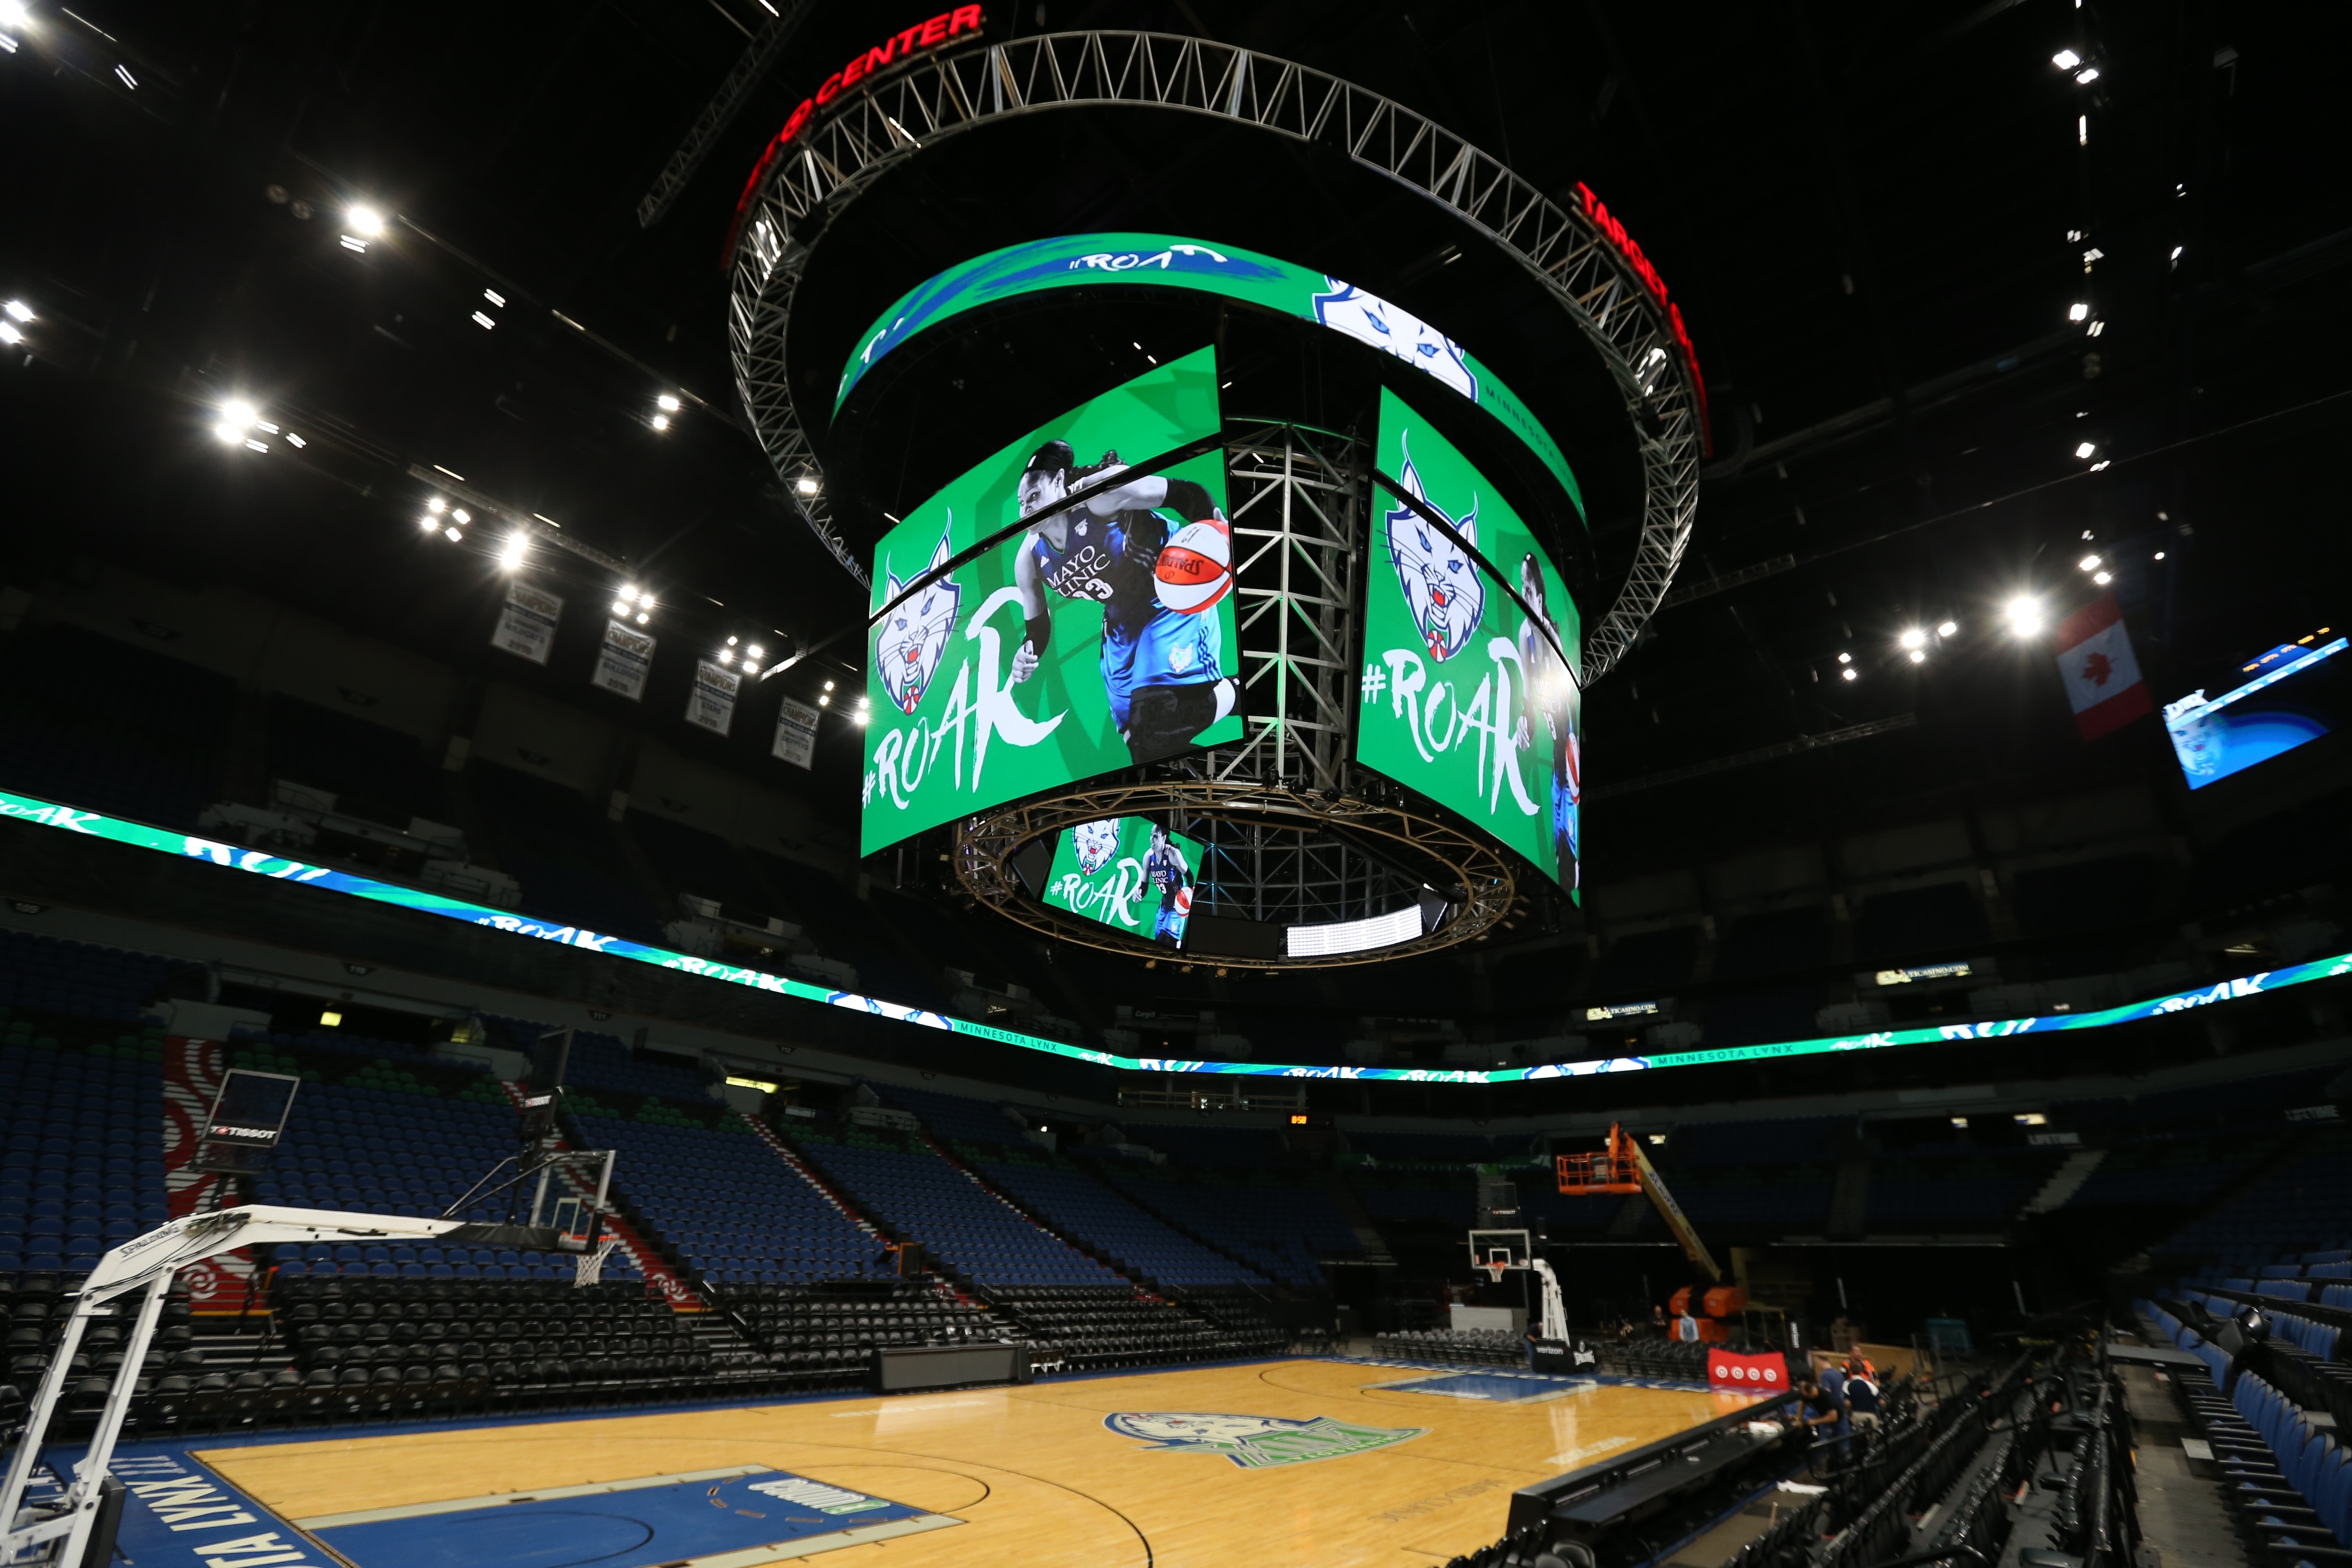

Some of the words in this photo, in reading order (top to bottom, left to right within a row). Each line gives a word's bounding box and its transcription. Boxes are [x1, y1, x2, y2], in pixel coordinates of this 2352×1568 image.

[816, 4, 982, 105] CENTER
[1576, 181, 1669, 307] TARGET
[1046, 545, 1096, 589] MAYO
[1361, 637, 1541, 815] #ROAR
[1049, 857, 1141, 926] #ROAR
[1135, 1010, 1155, 1019] Cargill
[1610, 1004, 1656, 1014] TICASINO.COM
[961, 1022, 1026, 1045] MINNESOTA
[1031, 1038, 1057, 1052] LYNX
[1658, 1050, 1745, 1066] MINNESOTA
[1753, 1044, 1794, 1057] LYNX
[229, 1127, 278, 1139] TISSOT
[1291, 1115, 1307, 1124] 8:58
[120, 1224, 181, 1258] SPALDING
[1536, 1346, 1563, 1355] verizon
[124, 1474, 258, 1533] LYNX
